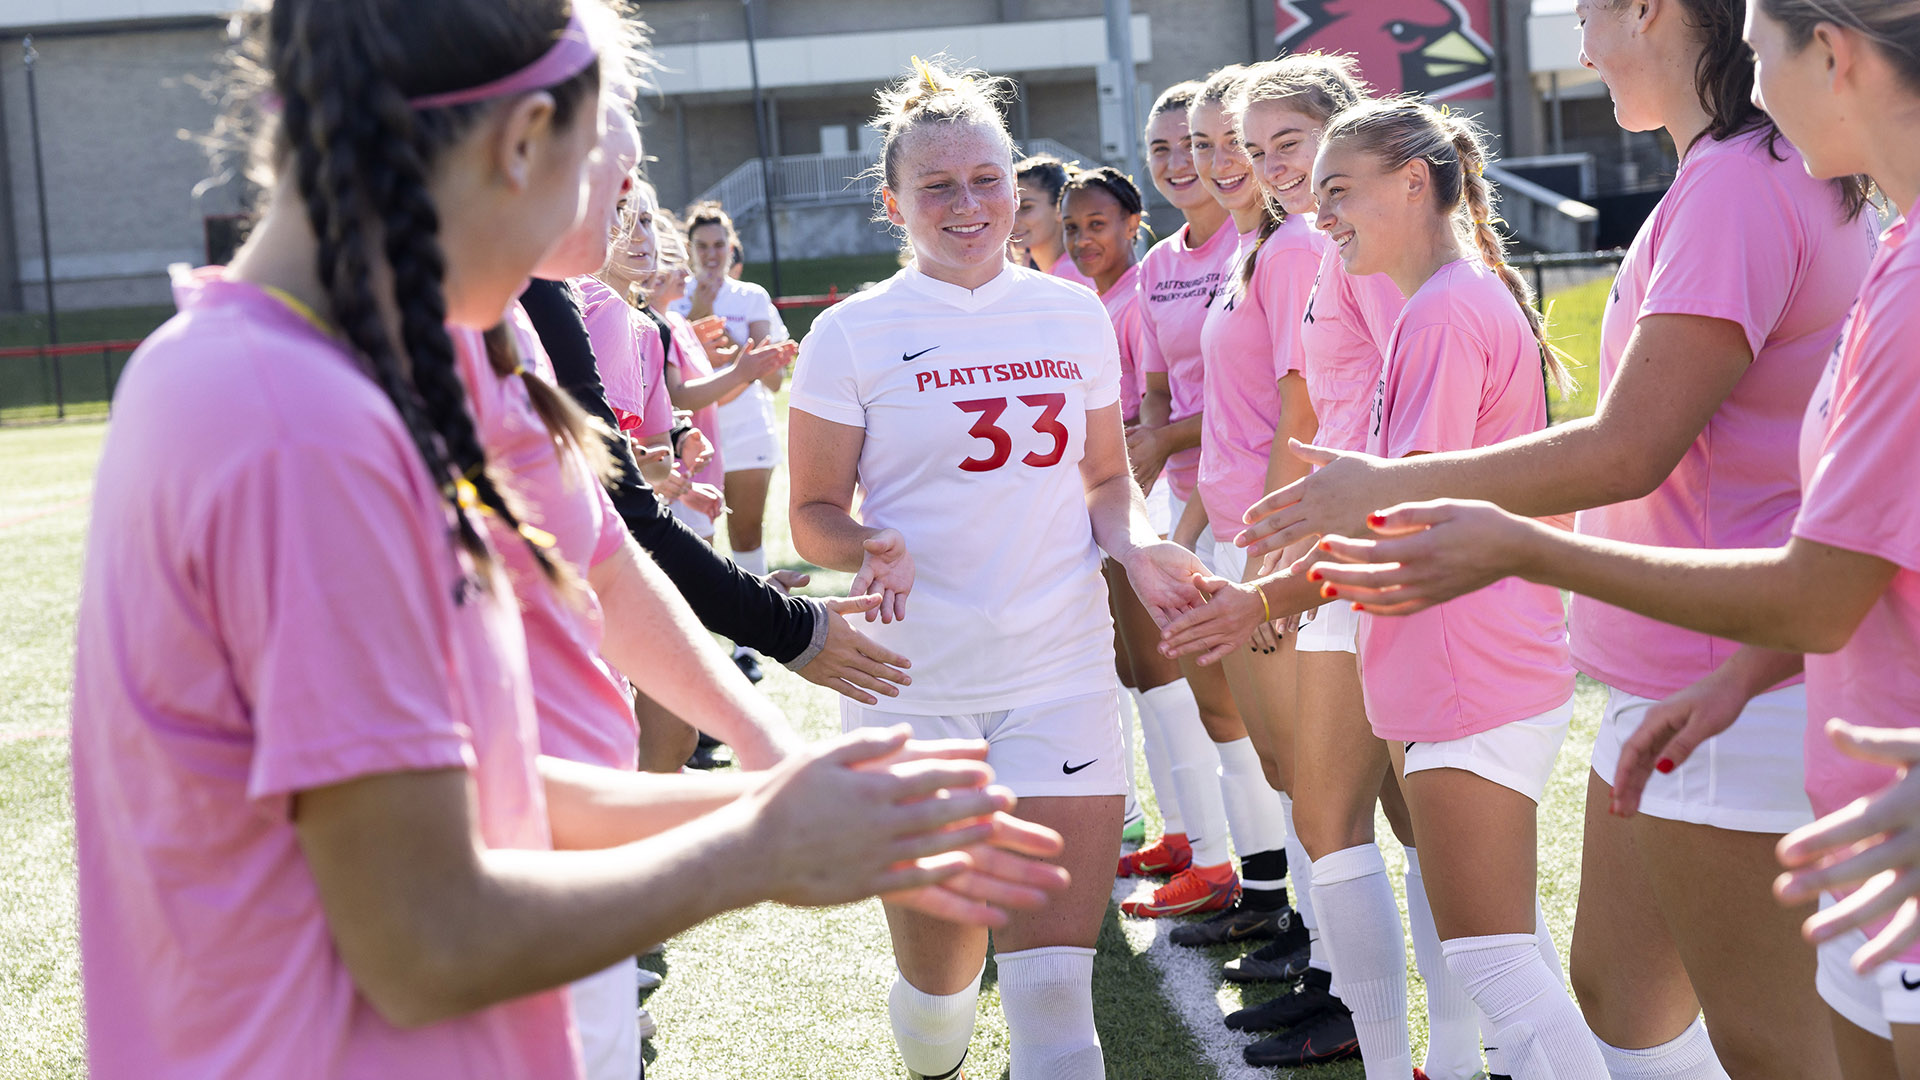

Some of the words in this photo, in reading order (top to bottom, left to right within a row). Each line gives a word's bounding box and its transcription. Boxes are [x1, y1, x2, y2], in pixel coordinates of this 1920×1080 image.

[1205, 272, 1221, 283] STA
[915, 359, 1083, 393] PLATTSBURGH
[952, 392, 1069, 473] 33
